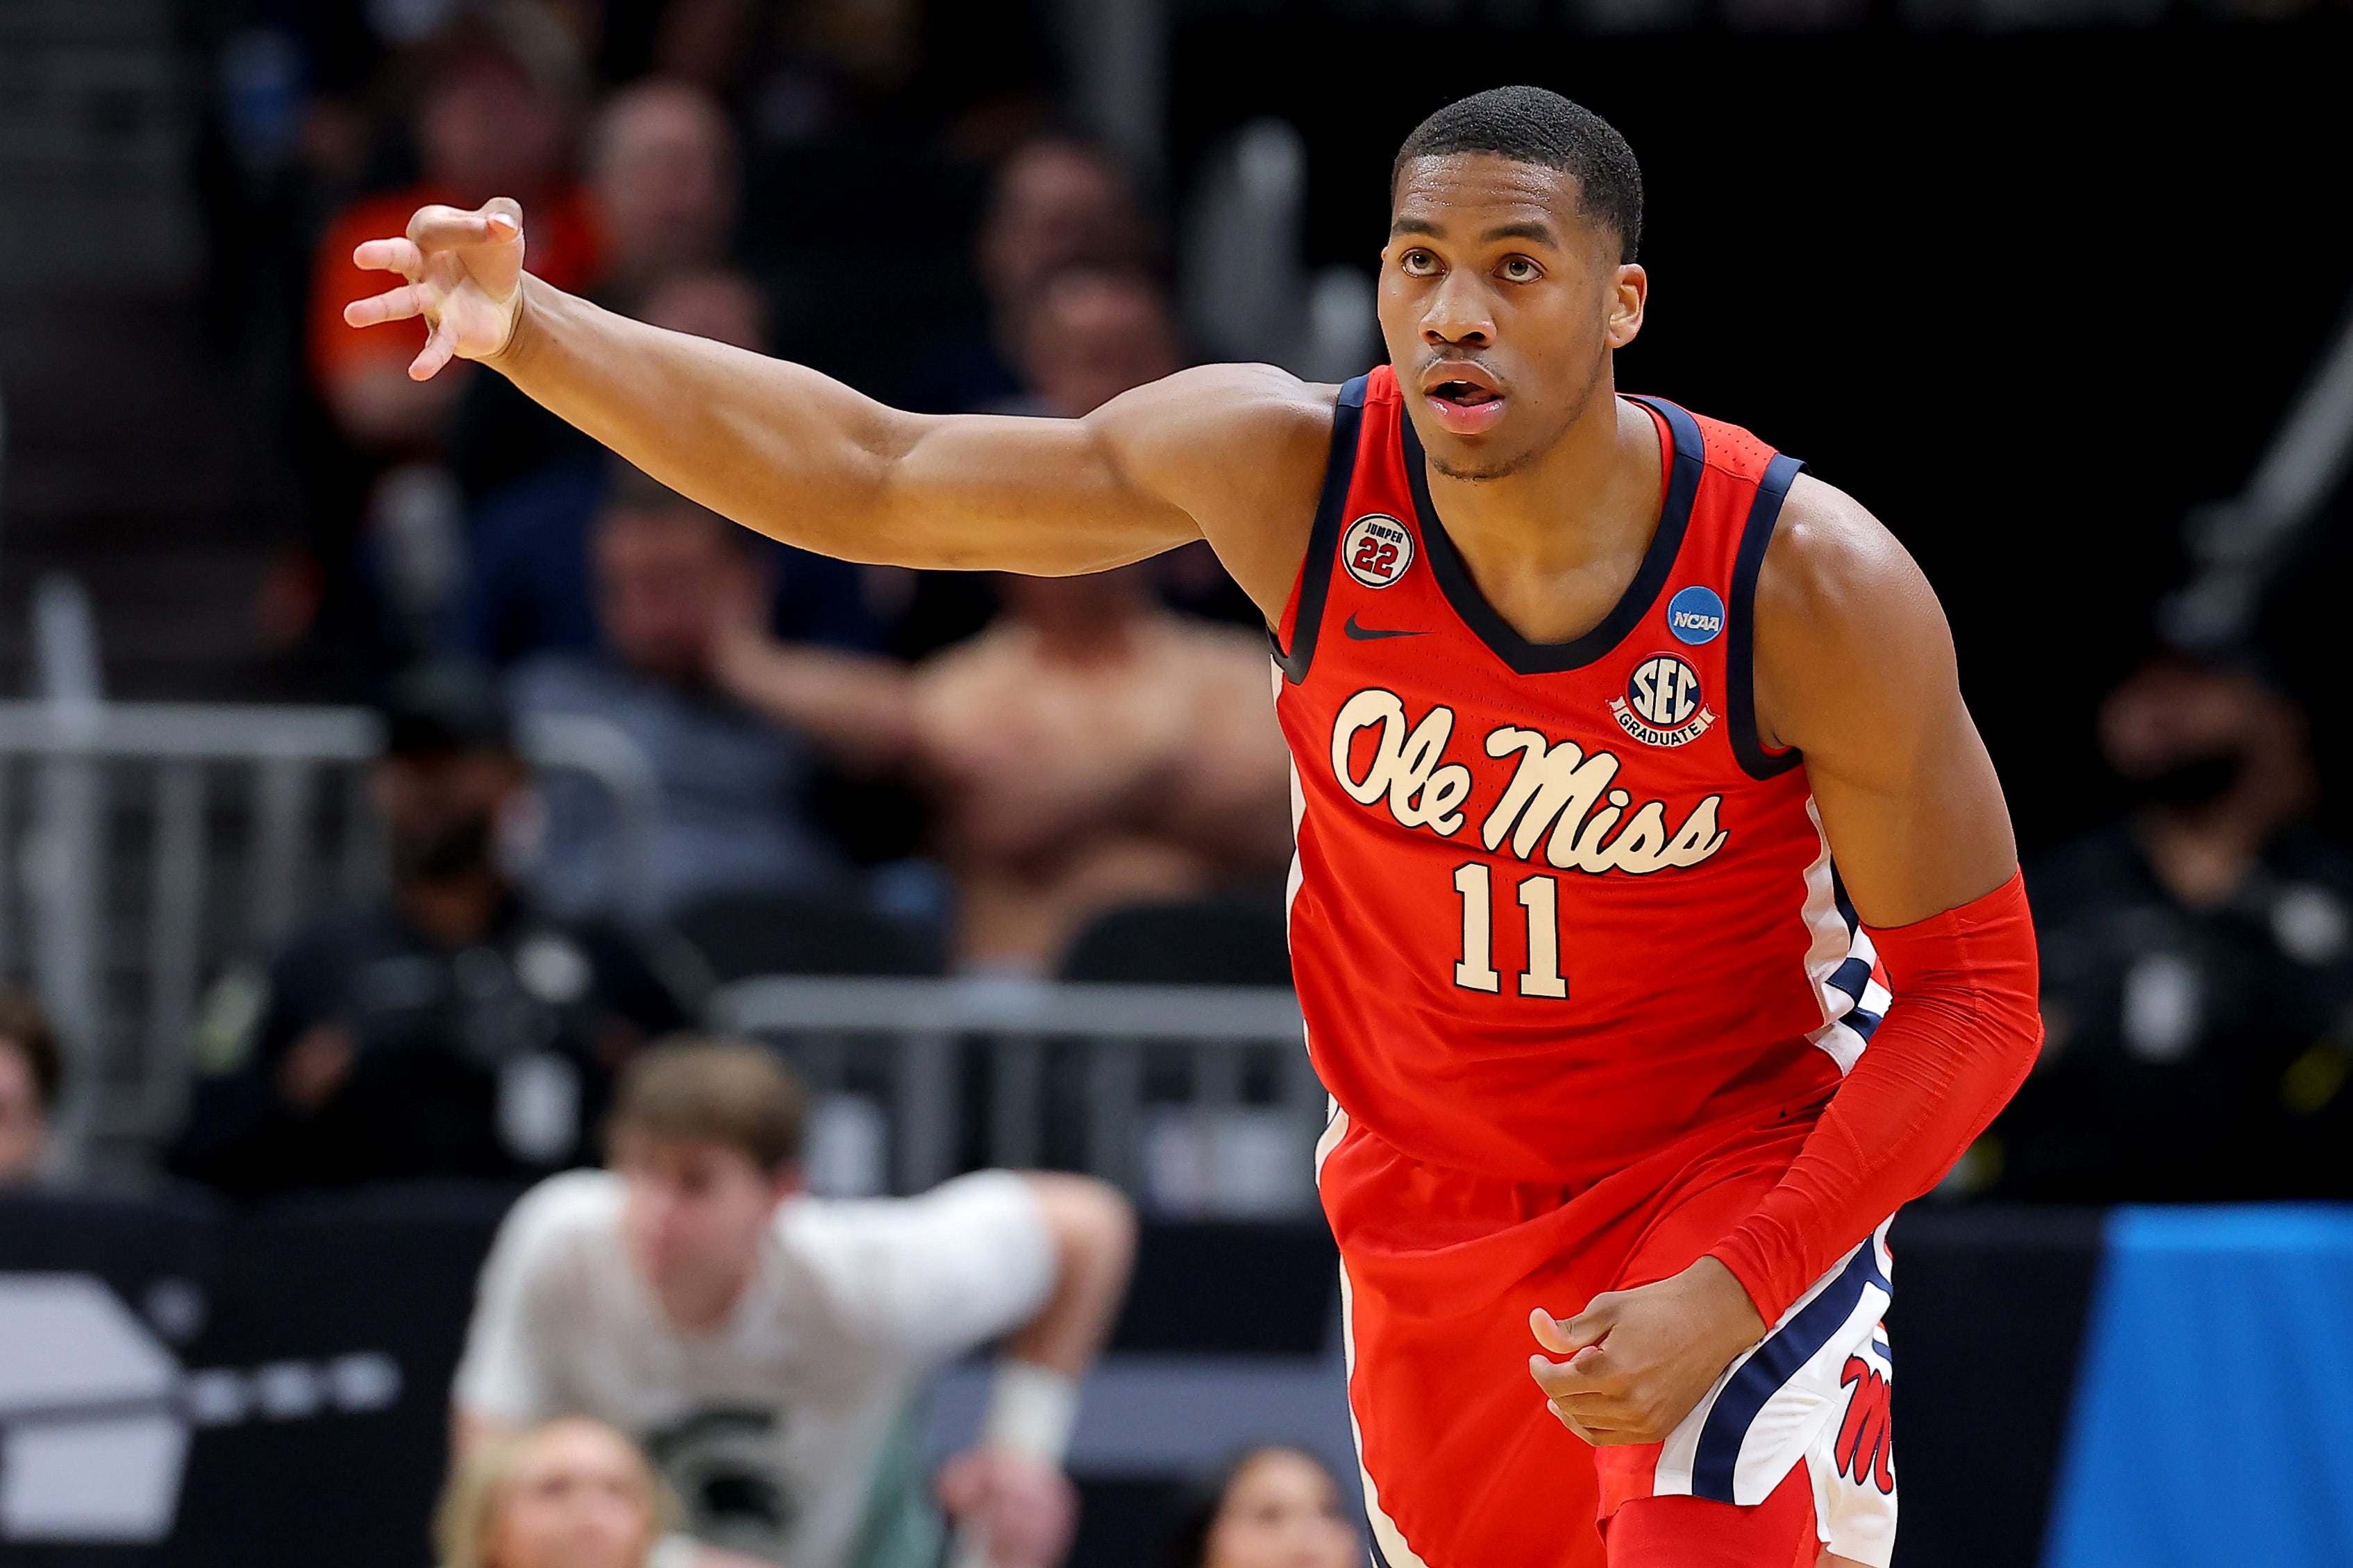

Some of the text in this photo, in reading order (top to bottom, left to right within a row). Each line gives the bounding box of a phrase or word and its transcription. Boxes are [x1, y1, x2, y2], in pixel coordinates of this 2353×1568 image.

[1365, 522, 1403, 543] JUMPER
[1353, 537, 1398, 578] 22
[1673, 612, 1720, 632] NCAA
[1632, 658, 1698, 724] SEC
[1619, 713, 1701, 745] GRADUATE
[1330, 688, 1730, 875] Ole Miss
[1455, 861, 1570, 1000] 11
